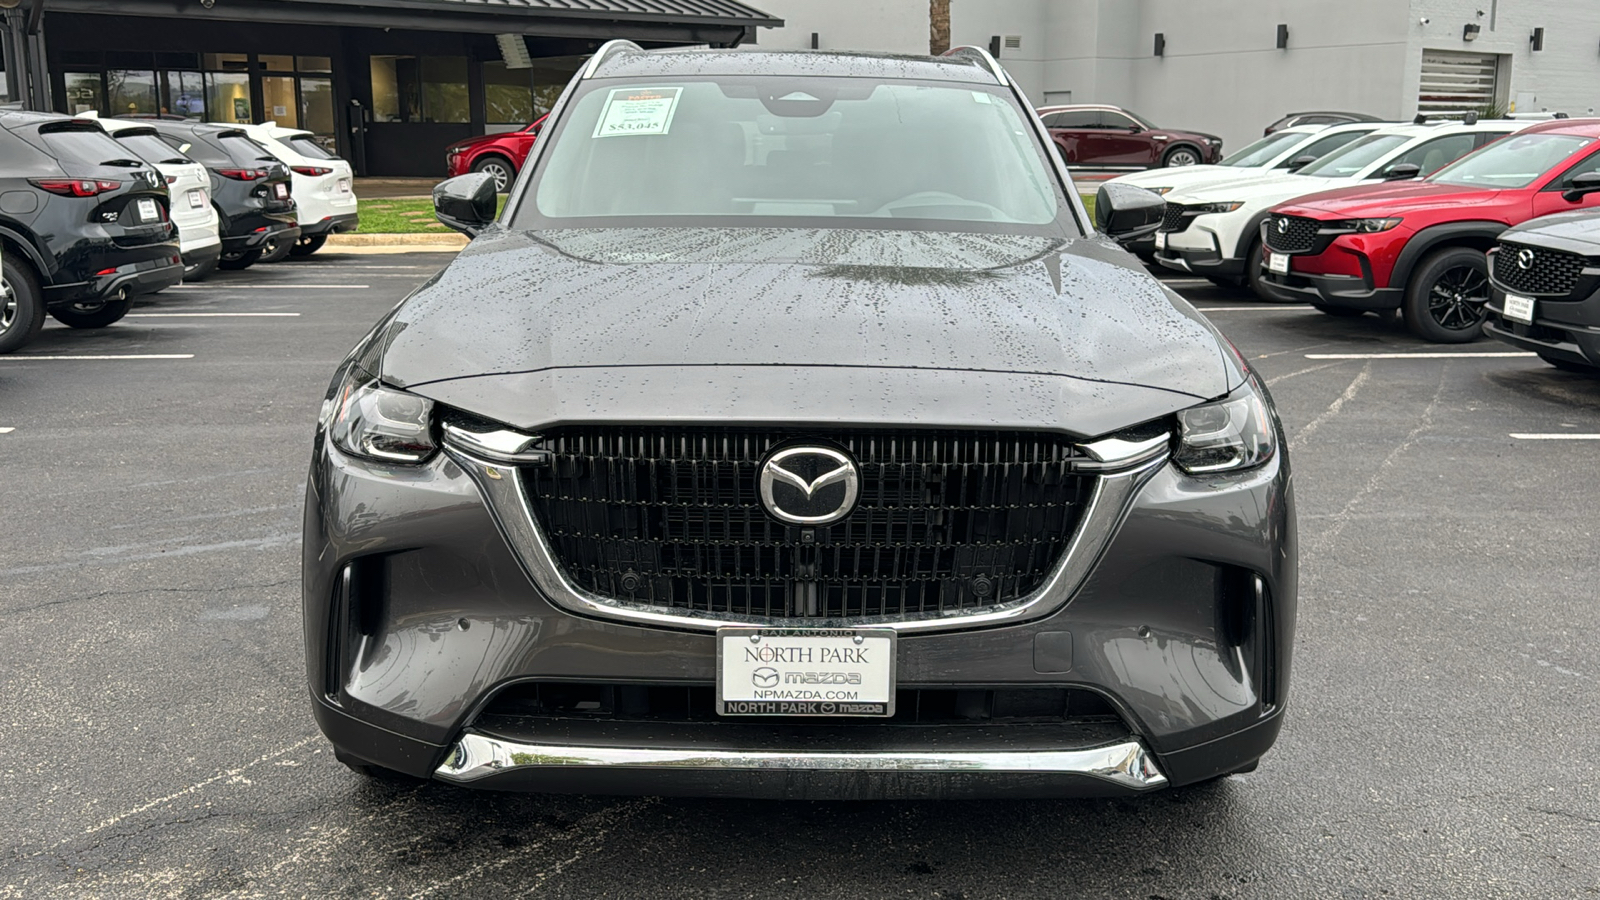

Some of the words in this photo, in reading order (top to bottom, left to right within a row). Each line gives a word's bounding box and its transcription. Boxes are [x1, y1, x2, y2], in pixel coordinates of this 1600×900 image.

[609, 122, 659, 131] $53,045
[793, 629, 853, 637] ANTONIO
[744, 646, 813, 663] NORTH
[820, 647, 869, 664] PARK
[785, 671, 862, 685] mazda
[754, 690, 858, 700] NPMAZDA.COM
[727, 702, 776, 713] NORTH
[780, 702, 818, 714] PARK
[839, 703, 883, 714] mazda
